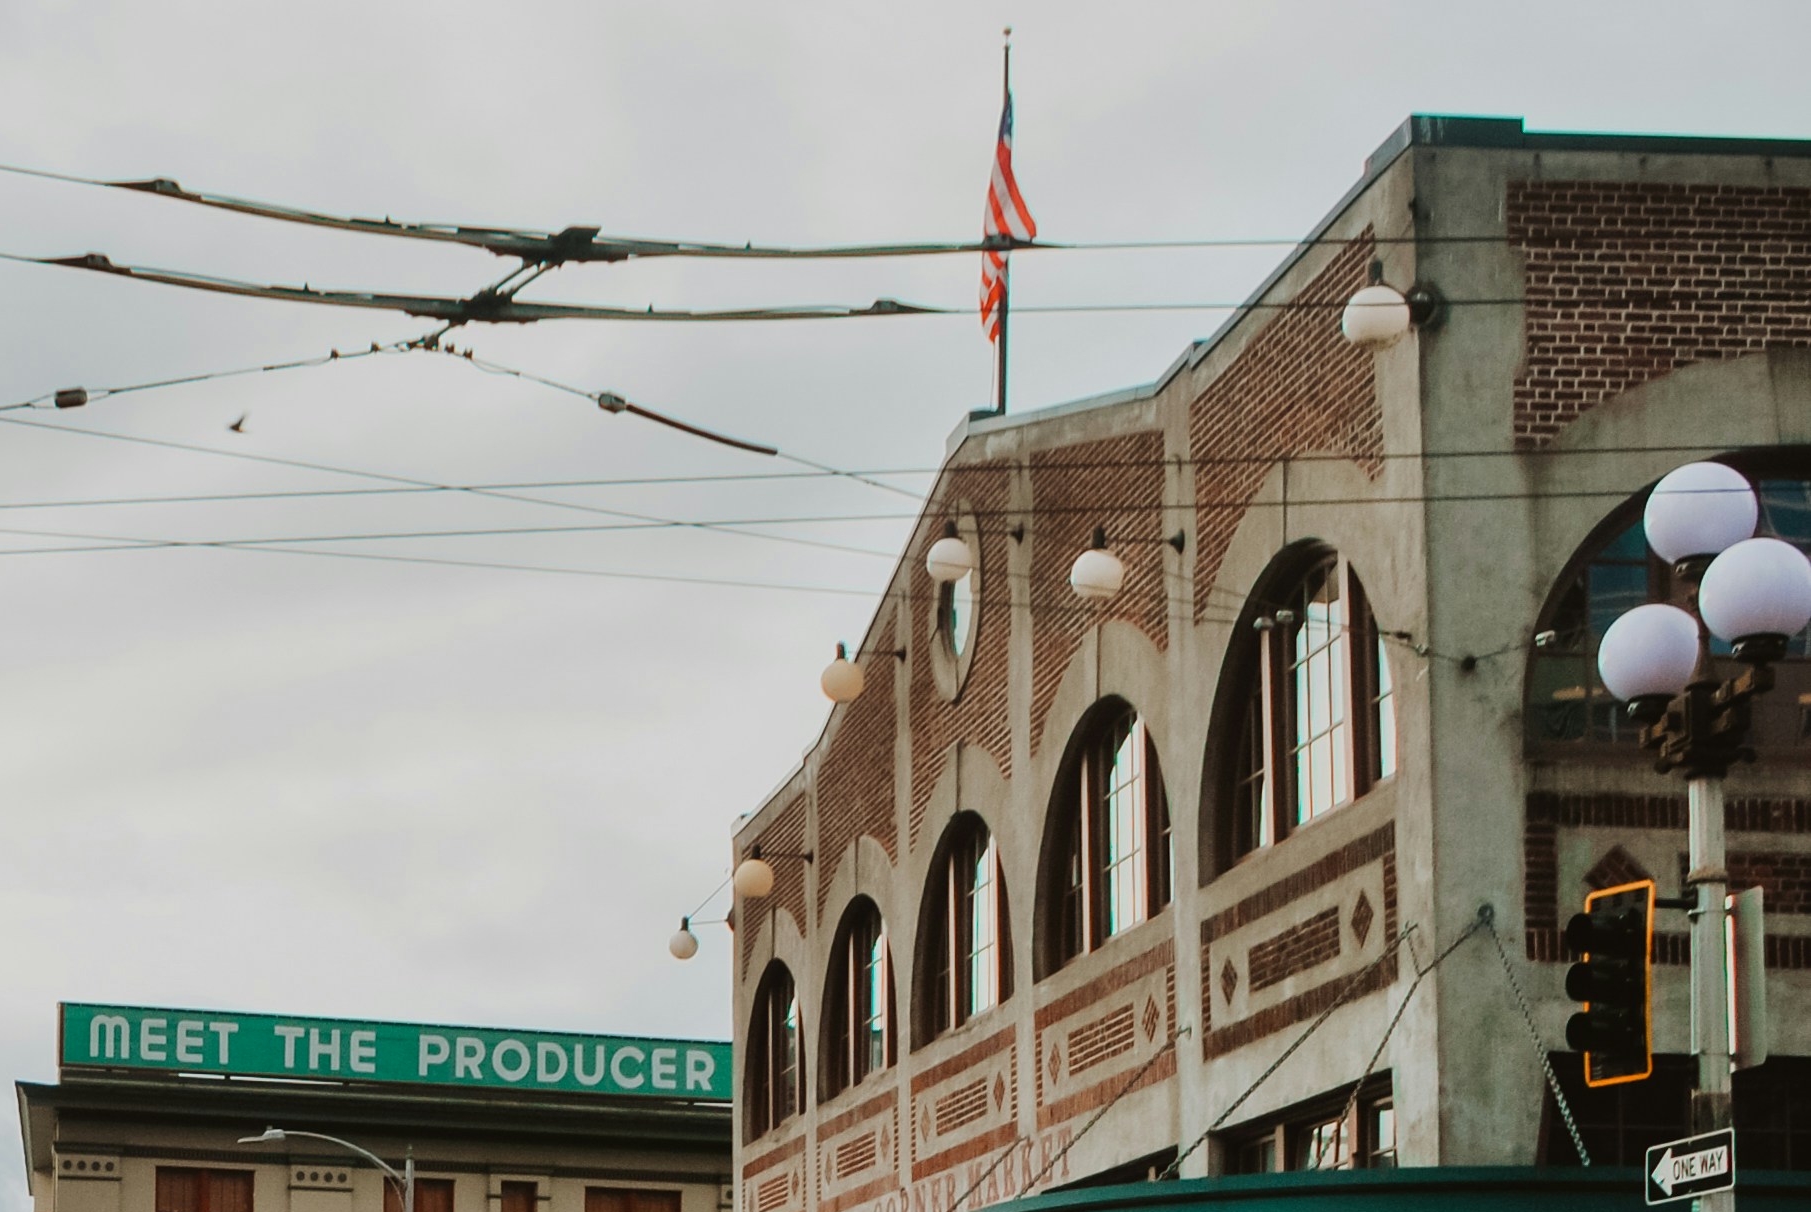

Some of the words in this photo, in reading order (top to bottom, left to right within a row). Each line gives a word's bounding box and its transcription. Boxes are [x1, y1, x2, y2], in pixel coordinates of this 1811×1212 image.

[89, 1014, 239, 1065] MEET
[274, 1025, 377, 1073] THE
[418, 1035, 716, 1091] PRODUCER
[967, 1126, 1073, 1210] MARKET
[1673, 1156, 1696, 1181] ONE
[1700, 1150, 1724, 1174] WAY
